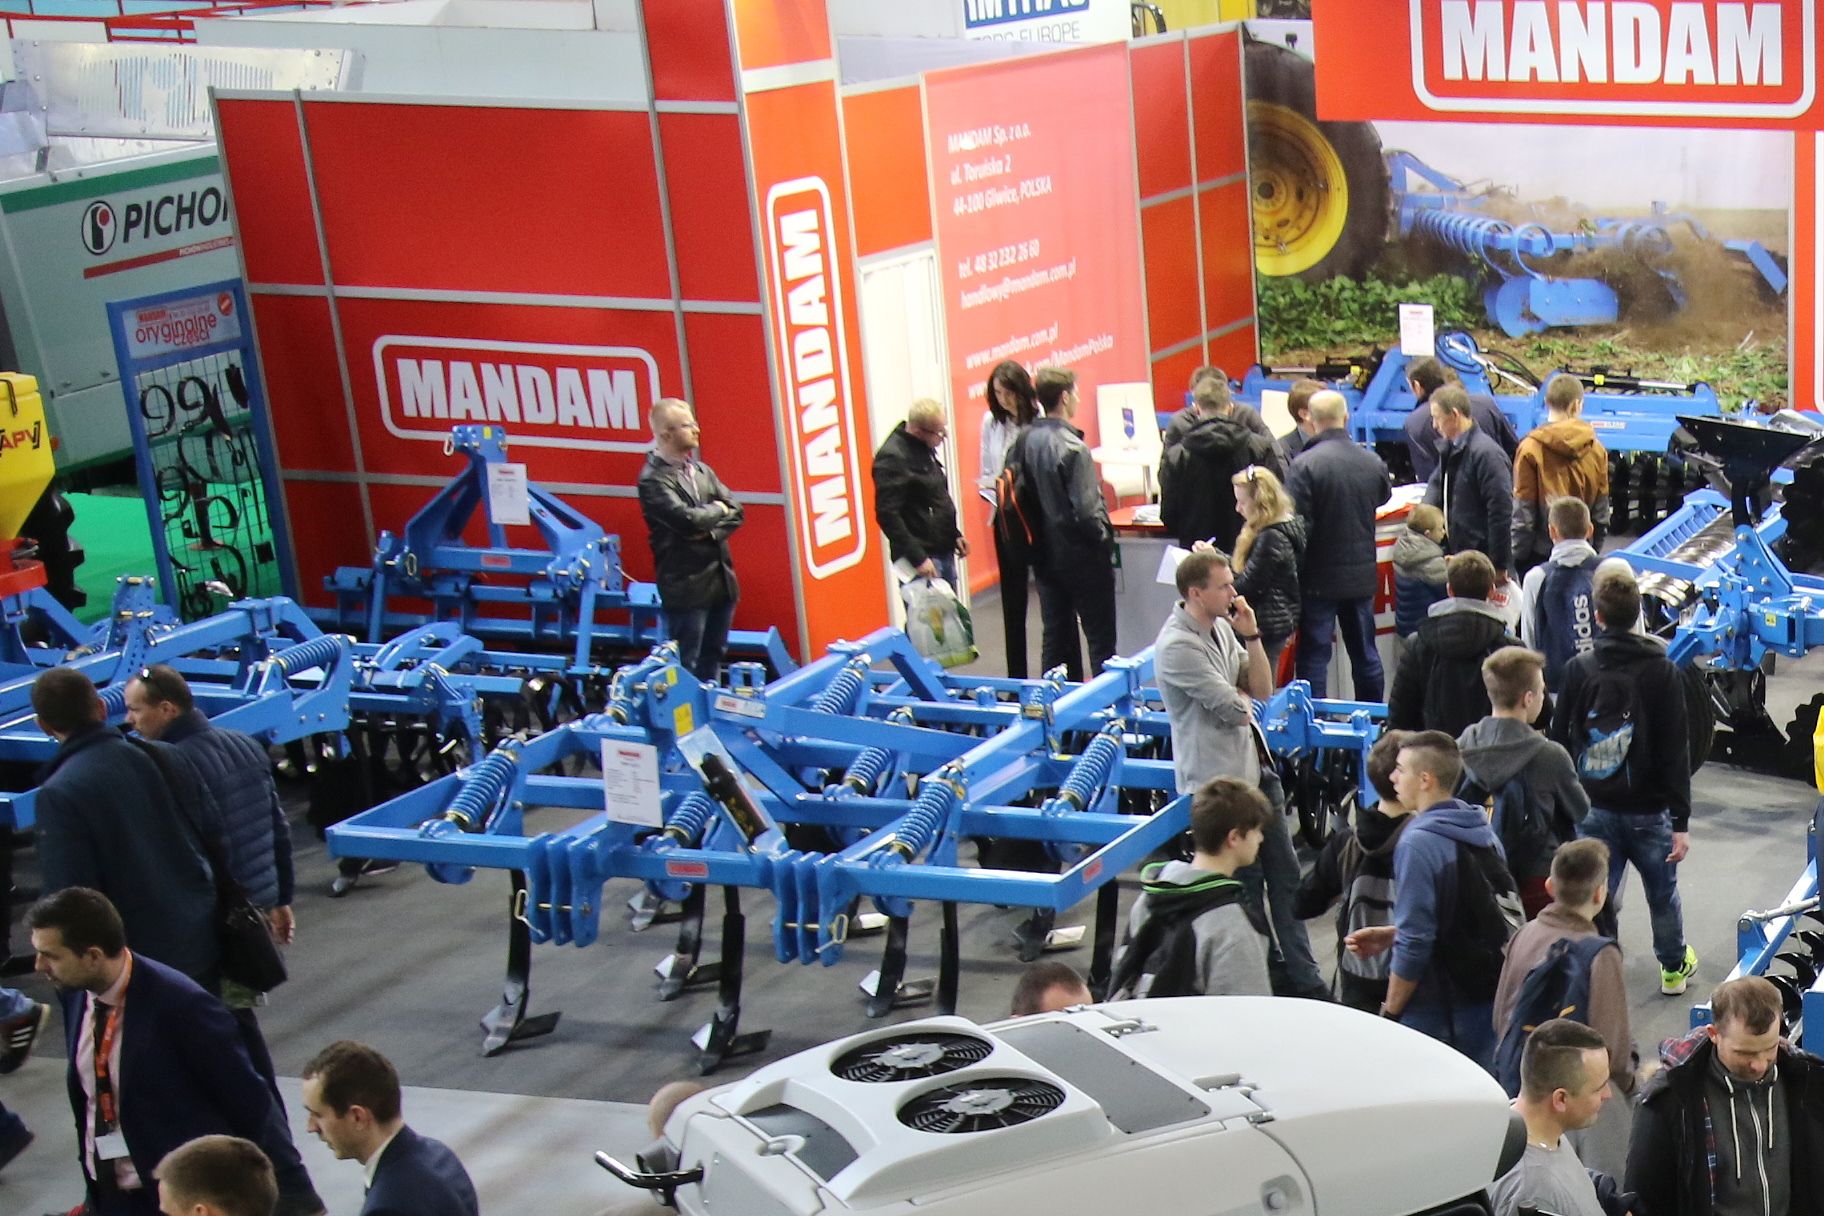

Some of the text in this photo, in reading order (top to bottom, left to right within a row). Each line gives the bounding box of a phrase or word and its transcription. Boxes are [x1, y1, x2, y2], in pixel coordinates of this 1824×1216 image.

[1443, 1, 1783, 86] MANDAM
[396, 358, 641, 430] MANDAM
[780, 209, 852, 547] MANDAM
